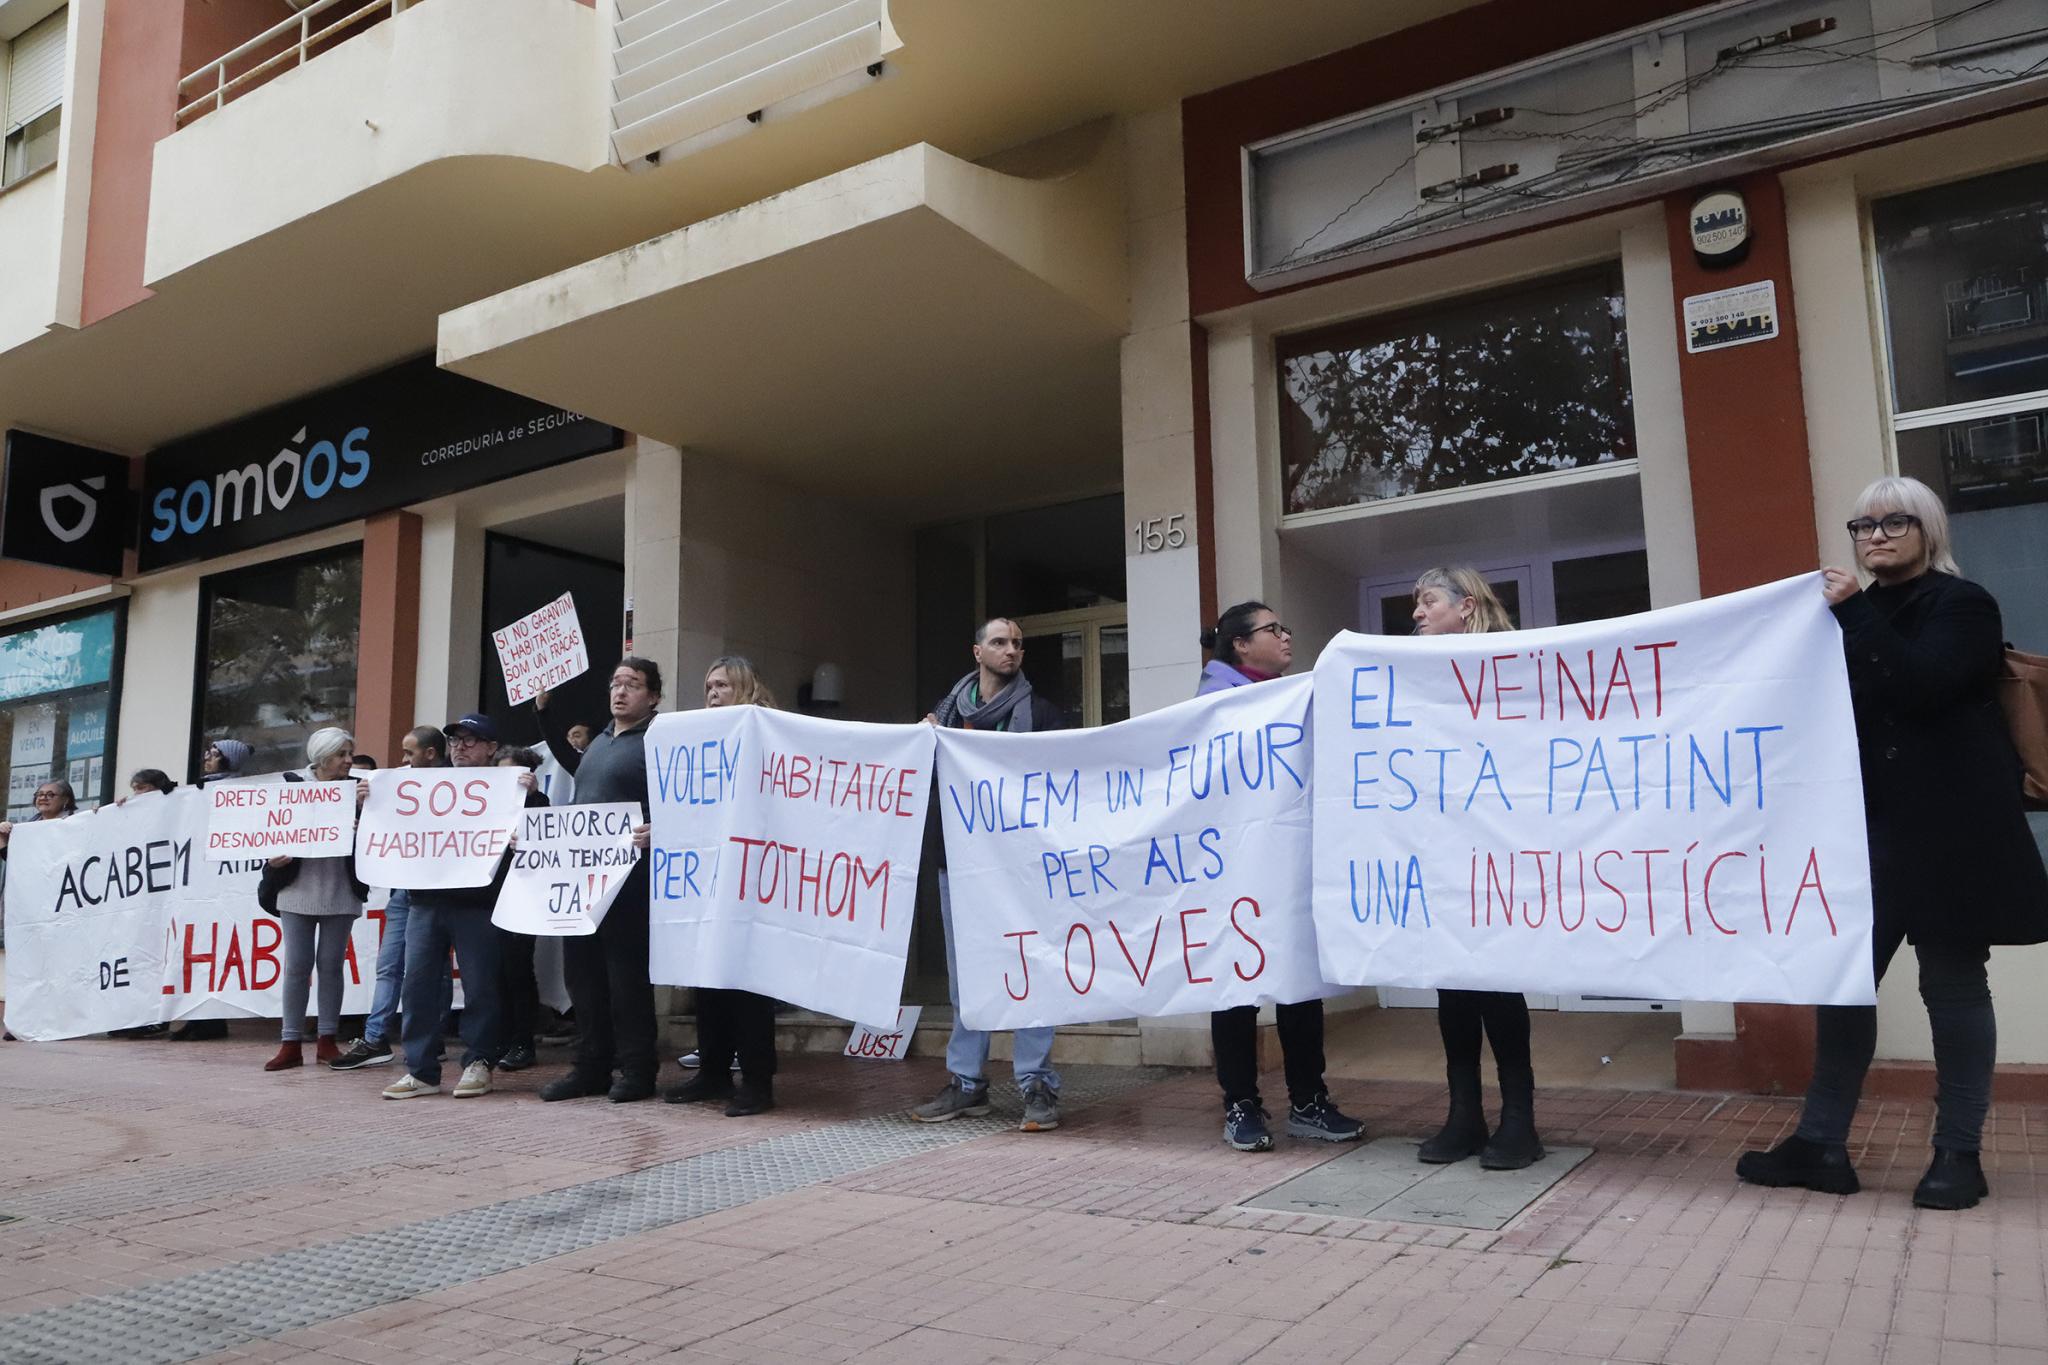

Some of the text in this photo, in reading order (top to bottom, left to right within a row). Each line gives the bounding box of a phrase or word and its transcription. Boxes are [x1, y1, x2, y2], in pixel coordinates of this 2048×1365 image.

[508, 426, 524, 441] de
[1134, 513, 1186, 554] 155
[496, 595, 573, 649] SI NO GARANTIM
[506, 660, 530, 682] SOM
[533, 650, 548, 669] UN
[510, 684, 523, 702] DE
[528, 659, 572, 694] SOCIETAT
[1351, 640, 1677, 729] EL VEÏNAT
[20, 736, 45, 751] VENTA
[655, 737, 741, 805] VOLEM
[949, 722, 1304, 834] VOLEM UN FUTUR
[1353, 741, 1512, 813] ESTÀ
[215, 786, 341, 808] DRETS HUMANS
[395, 779, 490, 817] SOS
[210, 827, 339, 849] DESNONAMENTS
[267, 809, 293, 827] NO
[525, 810, 632, 841] MENORCA
[365, 829, 507, 858] HABITATGE
[515, 845, 638, 869] ZONA TENSADA
[1042, 828, 1224, 899] PER ALS
[55, 837, 191, 912] ACABEM
[653, 848, 701, 901] PER
[729, 836, 890, 931] TOTHOM
[1350, 854, 1431, 929] UNA
[1003, 896, 1266, 1001] JOVES
[100, 956, 130, 990] DE
